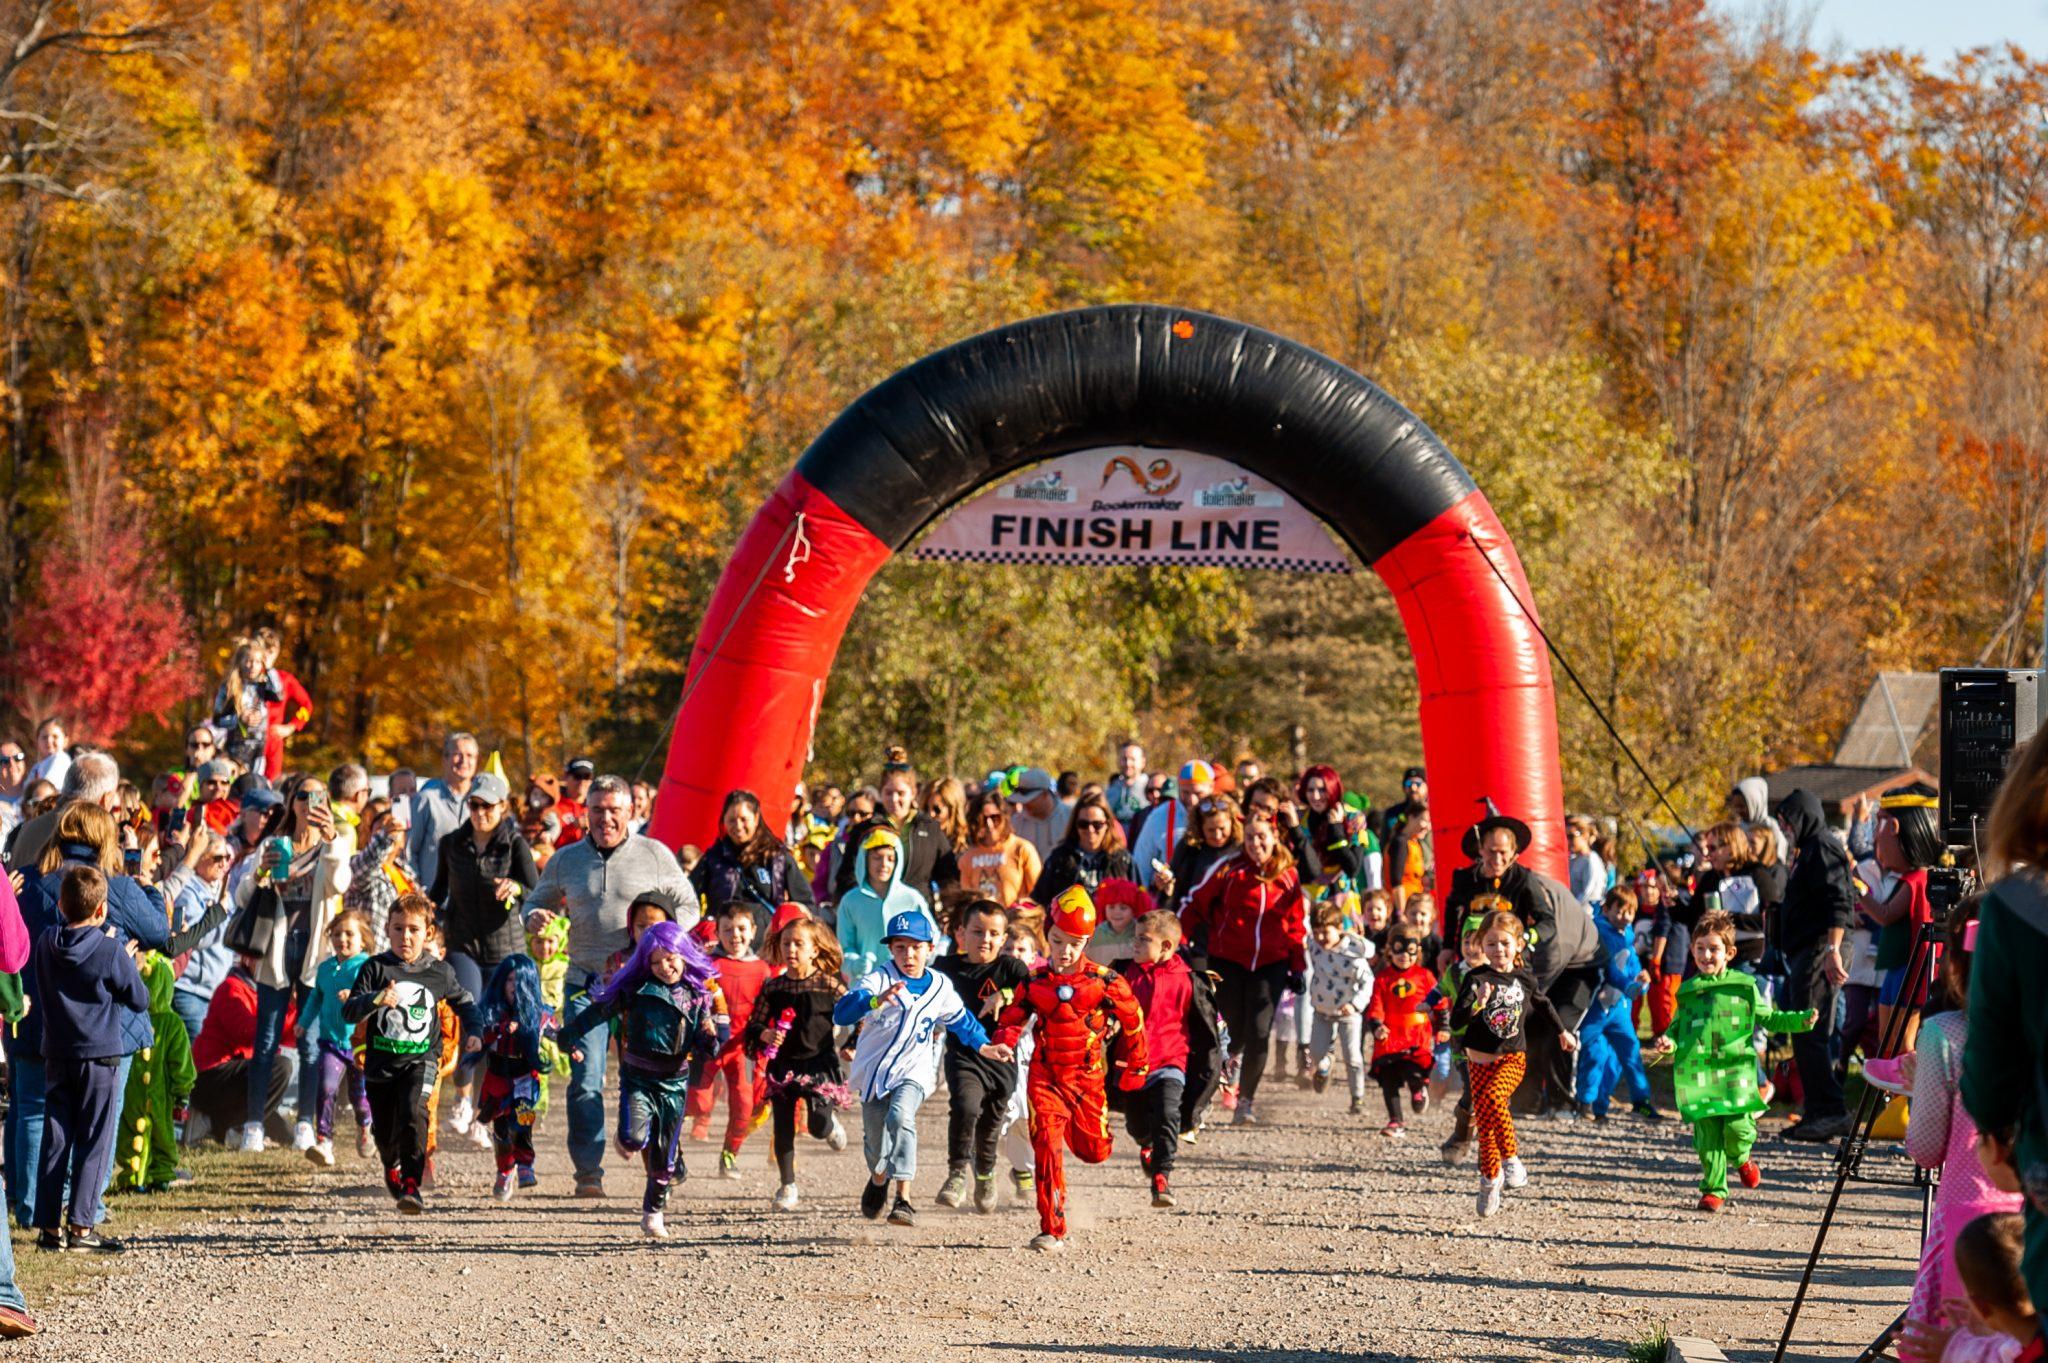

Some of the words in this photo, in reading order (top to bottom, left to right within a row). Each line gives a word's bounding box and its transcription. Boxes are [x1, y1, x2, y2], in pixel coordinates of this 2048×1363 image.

[991, 514, 1152, 550] FINISH
[1170, 520, 1280, 551] LINE
[896, 915, 910, 930] LA
[916, 1017, 934, 1043] 3
